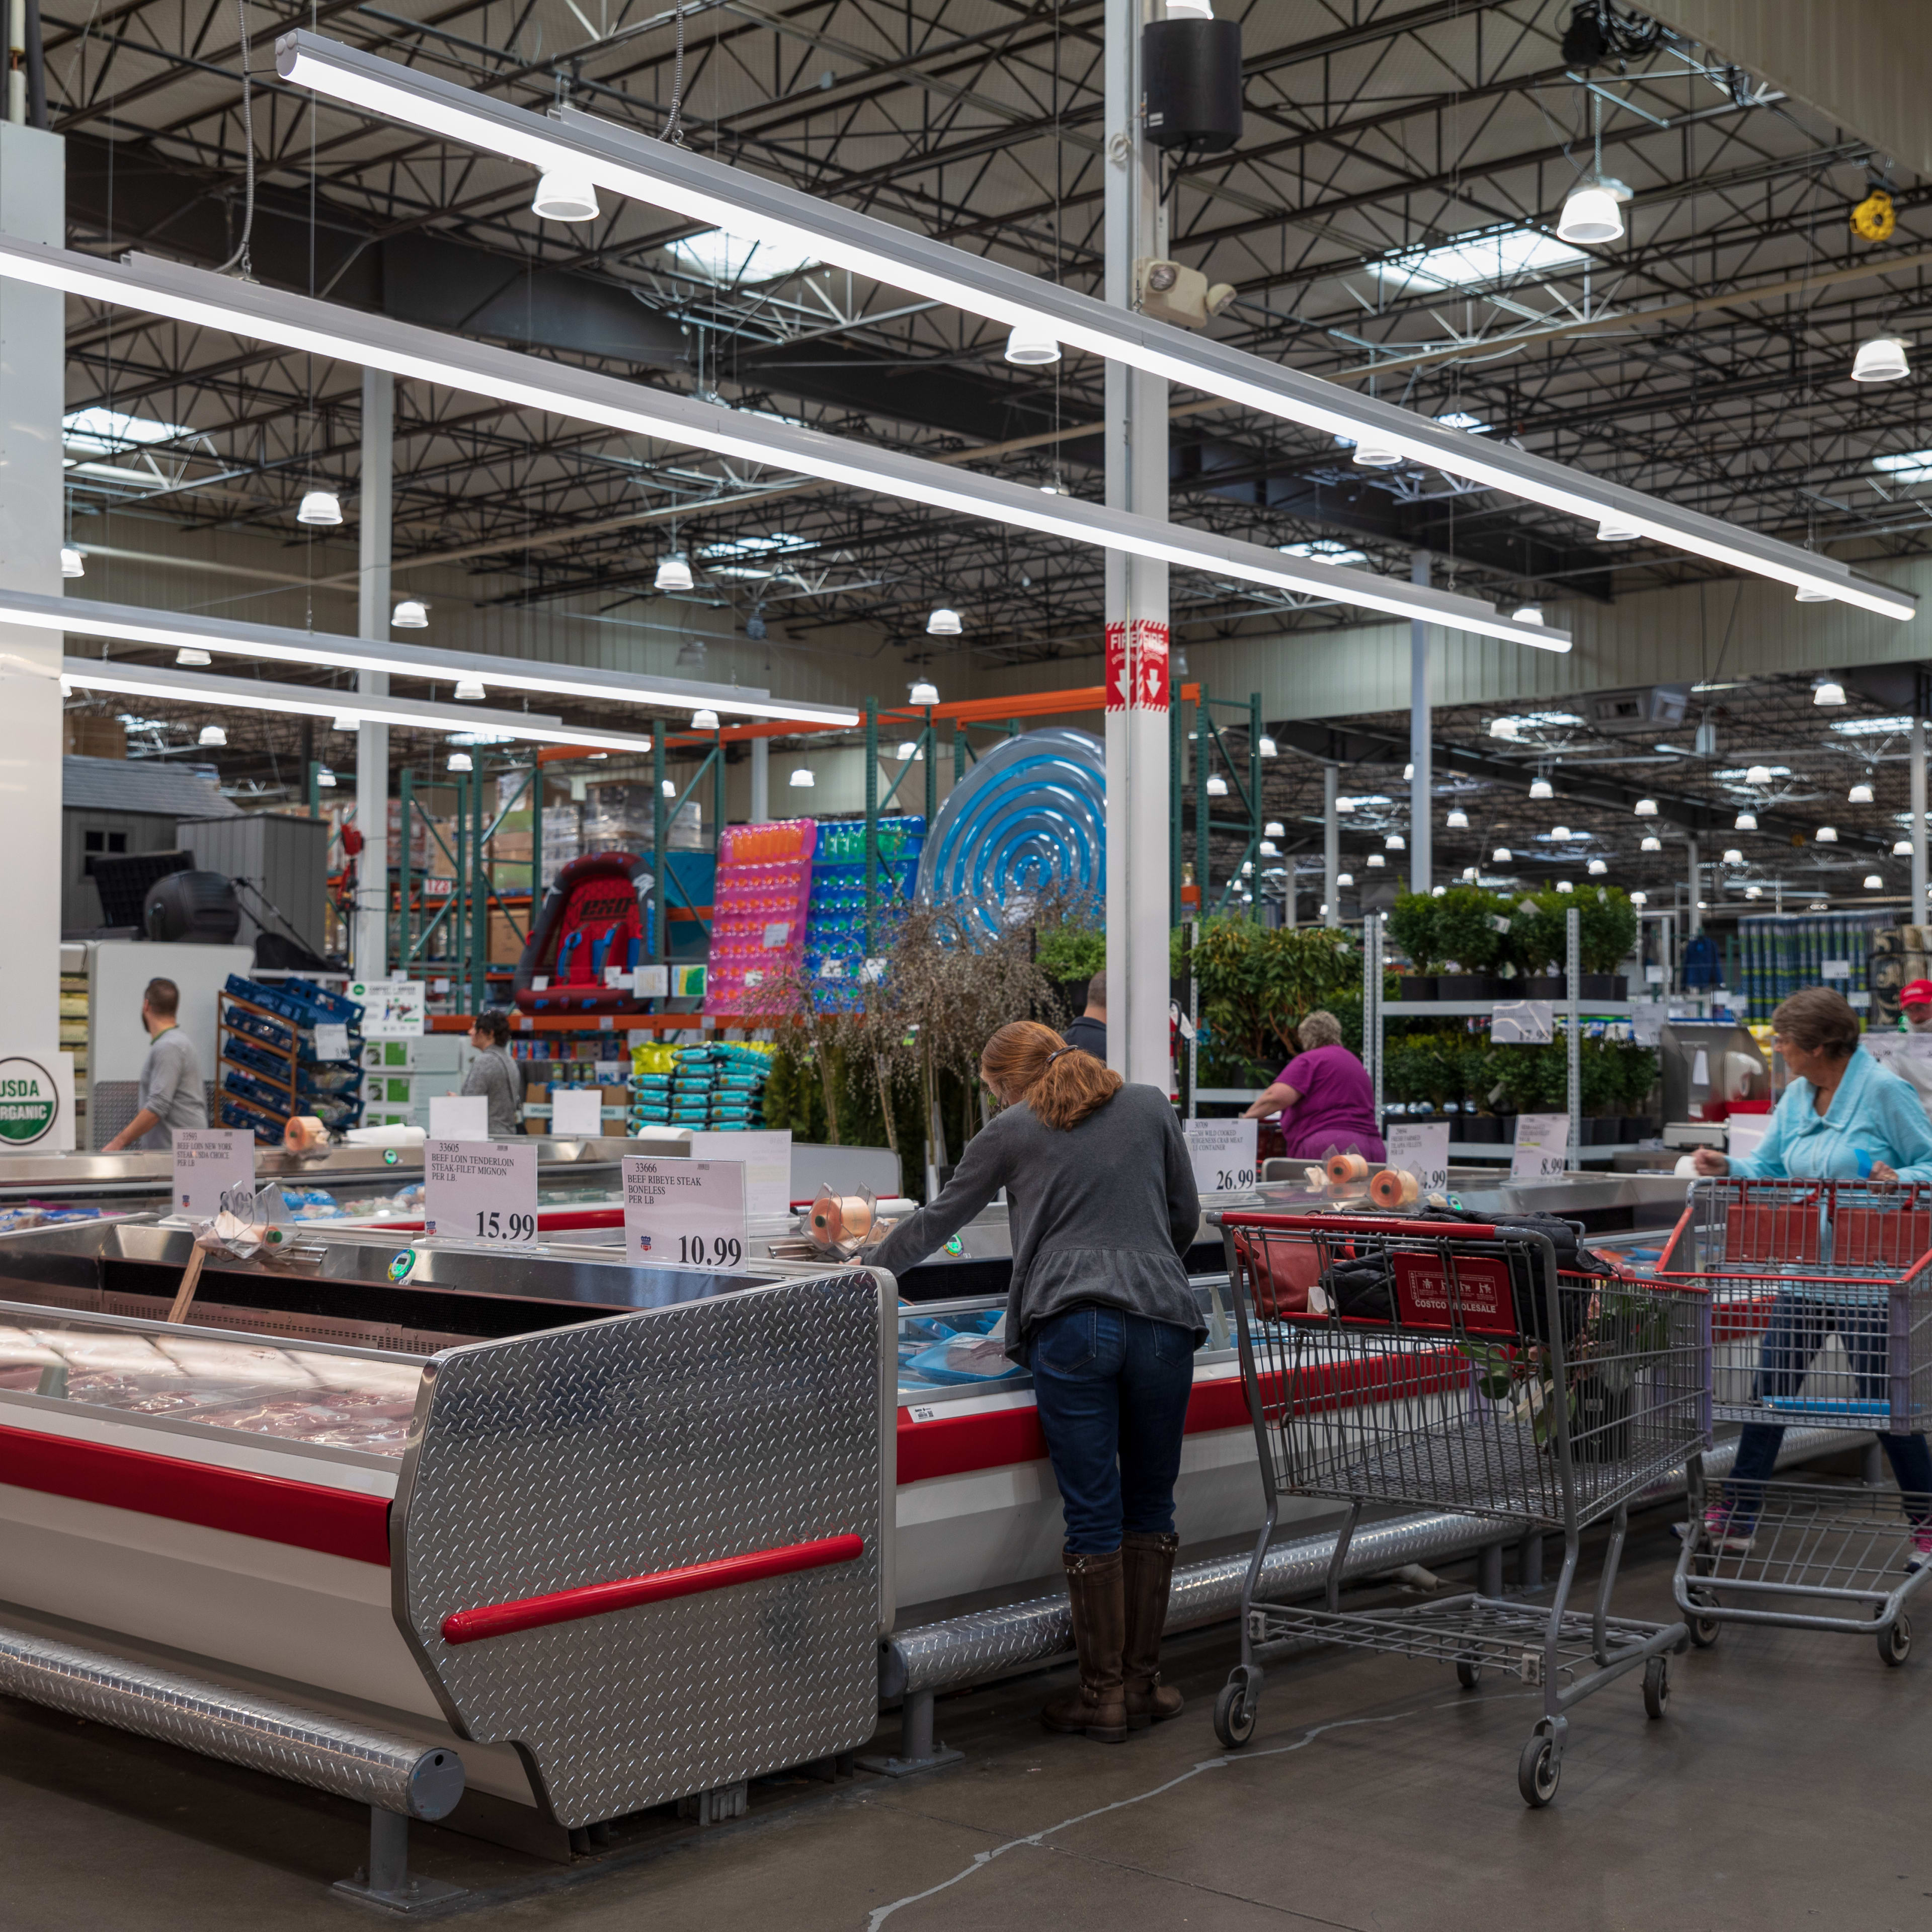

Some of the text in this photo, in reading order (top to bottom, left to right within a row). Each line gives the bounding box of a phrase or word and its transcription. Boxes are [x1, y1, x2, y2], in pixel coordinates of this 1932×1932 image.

[0, 1080, 40, 1097] USDA
[0, 1105, 47, 1120] RGANIC
[439, 1143, 459, 1153] 33605
[432, 1153, 514, 1166] BEEF LOIN TENDERLOIN
[432, 1163, 507, 1176] STEAK-FILET MIGNON
[635, 1163, 657, 1173] 33666
[1541, 1158, 1563, 1175] 8.99
[432, 1172, 457, 1181] PER LB.
[628, 1175, 701, 1186] BEEF RIBEYE STEAK
[1217, 1169, 1254, 1190] 26.99
[628, 1185, 666, 1195] BONELESS
[629, 1195, 654, 1204] PER LB
[476, 1211, 535, 1241] 15.99
[678, 1235, 742, 1267] 10.99
[1415, 1300, 1447, 1309] COSTCO
